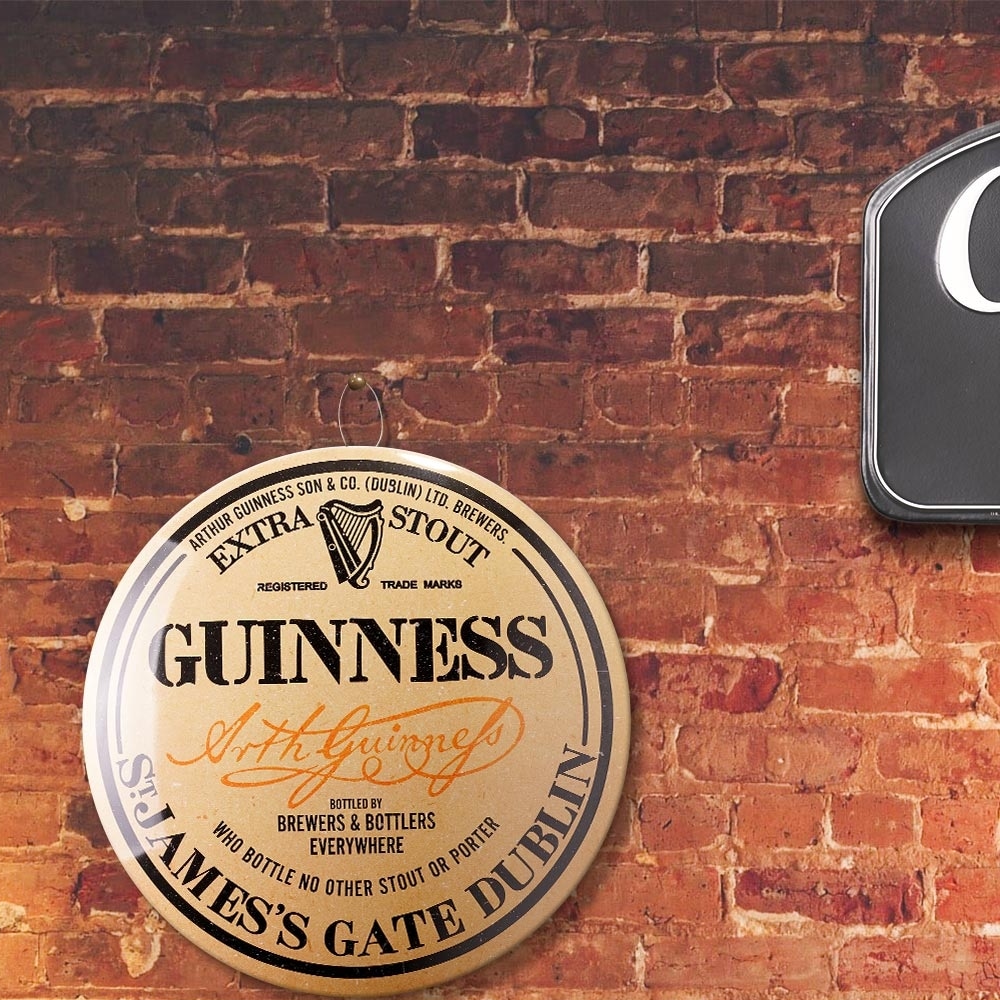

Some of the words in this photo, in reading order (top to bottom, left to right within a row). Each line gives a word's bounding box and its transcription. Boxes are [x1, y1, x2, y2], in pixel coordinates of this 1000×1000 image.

[188, 512, 234, 551] ARTHUR
[232, 485, 294, 520] GUINNESS
[296, 478, 323, 496] SON
[326, 477, 336, 491] &
[340, 476, 360, 490] CO.
[425, 488, 449, 510] LTD.
[452, 500, 509, 544] BREWERS.
[206, 505, 315, 575] EXTRA
[388, 505, 491, 568] STOUT
[257, 582, 328, 592] REGISTERED
[380, 580, 418, 589] TRADE
[424, 580, 463, 589] MARKS
[148, 615, 554, 688] GUINNESS
[278, 813, 345, 832] BREWERS
[350, 813, 361, 831] &
[365, 811, 436, 831] BOTTLERS
[330, 798, 368, 810] BOTTLED
[371, 798, 382, 809] BY
[133, 803, 310, 951] JAMES'S
[324, 898, 466, 958] GATE
[464, 743, 598, 919] DUBLIN
[212, 820, 244, 853] WHO
[241, 846, 297, 886] BOTTLE
[298, 873, 320, 893] NO
[325, 879, 373, 897] OTHER
[379, 867, 426, 895] STOUT
[428, 856, 451, 878] OR
[448, 816, 501, 865] PORTER
[310, 836, 404, 856] EVERYWHERE
